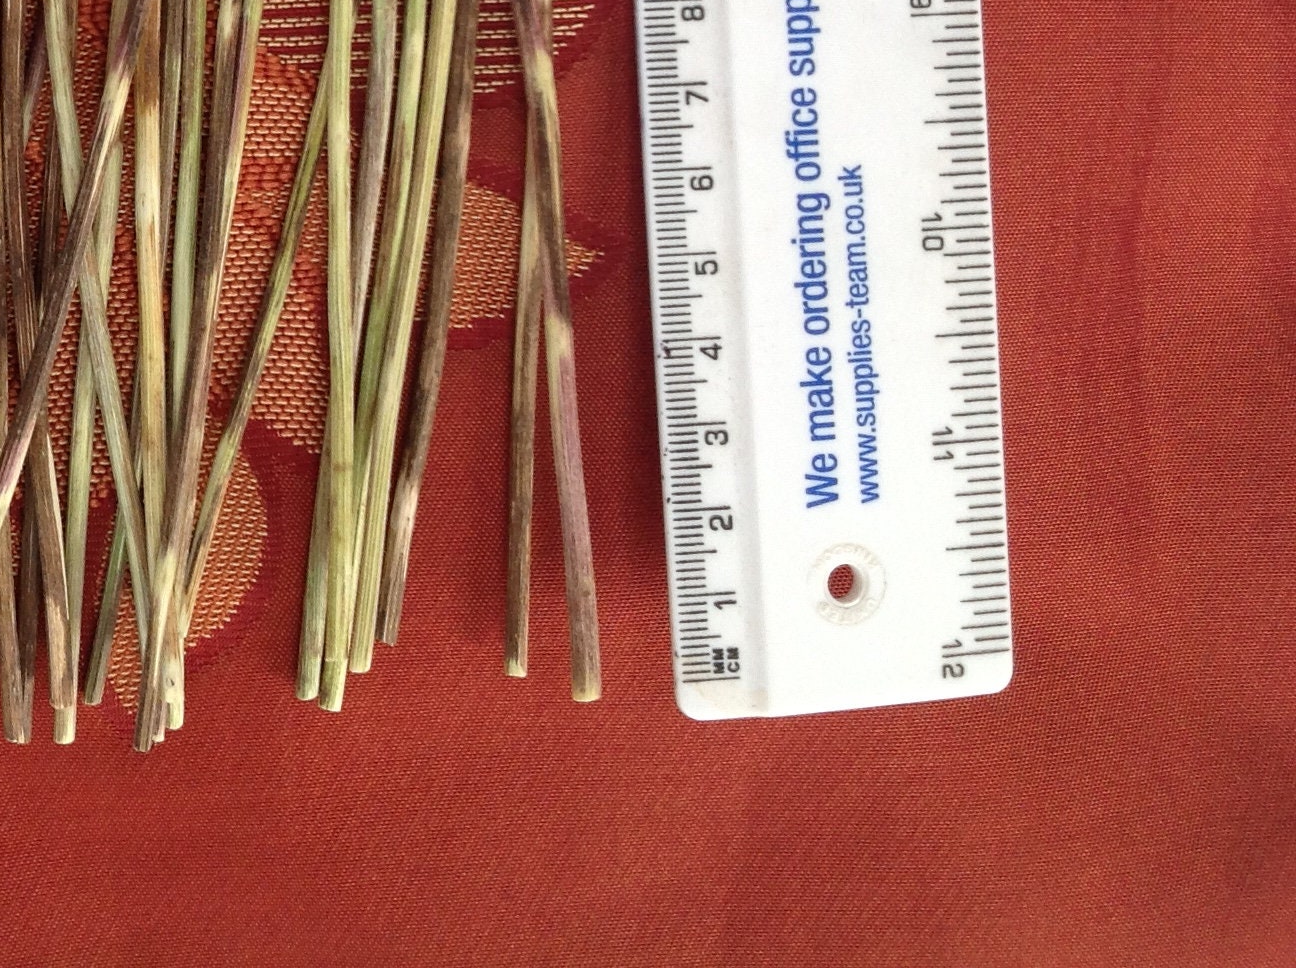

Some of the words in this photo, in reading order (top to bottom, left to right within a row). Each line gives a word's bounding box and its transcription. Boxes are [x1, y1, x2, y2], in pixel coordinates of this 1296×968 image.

[681, 5, 706, 22] 8
[685, 90, 709, 105] 7
[784, 87, 821, 183] office
[690, 174, 714, 191] 6
[921, 212, 944, 251] 10
[695, 260, 719, 276] 5
[791, 191, 831, 337] ordering
[837, 164, 880, 504] www.supplies-team.co.uk
[700, 343, 722, 360] 4
[798, 346, 836, 443] make
[704, 430, 729, 446] 3
[932, 426, 954, 461] 11
[804, 452, 839, 509] We
[710, 514, 734, 532] 2
[713, 599, 737, 610] 1
[727, 647, 740, 673] CM
[941, 639, 966, 679] 12
